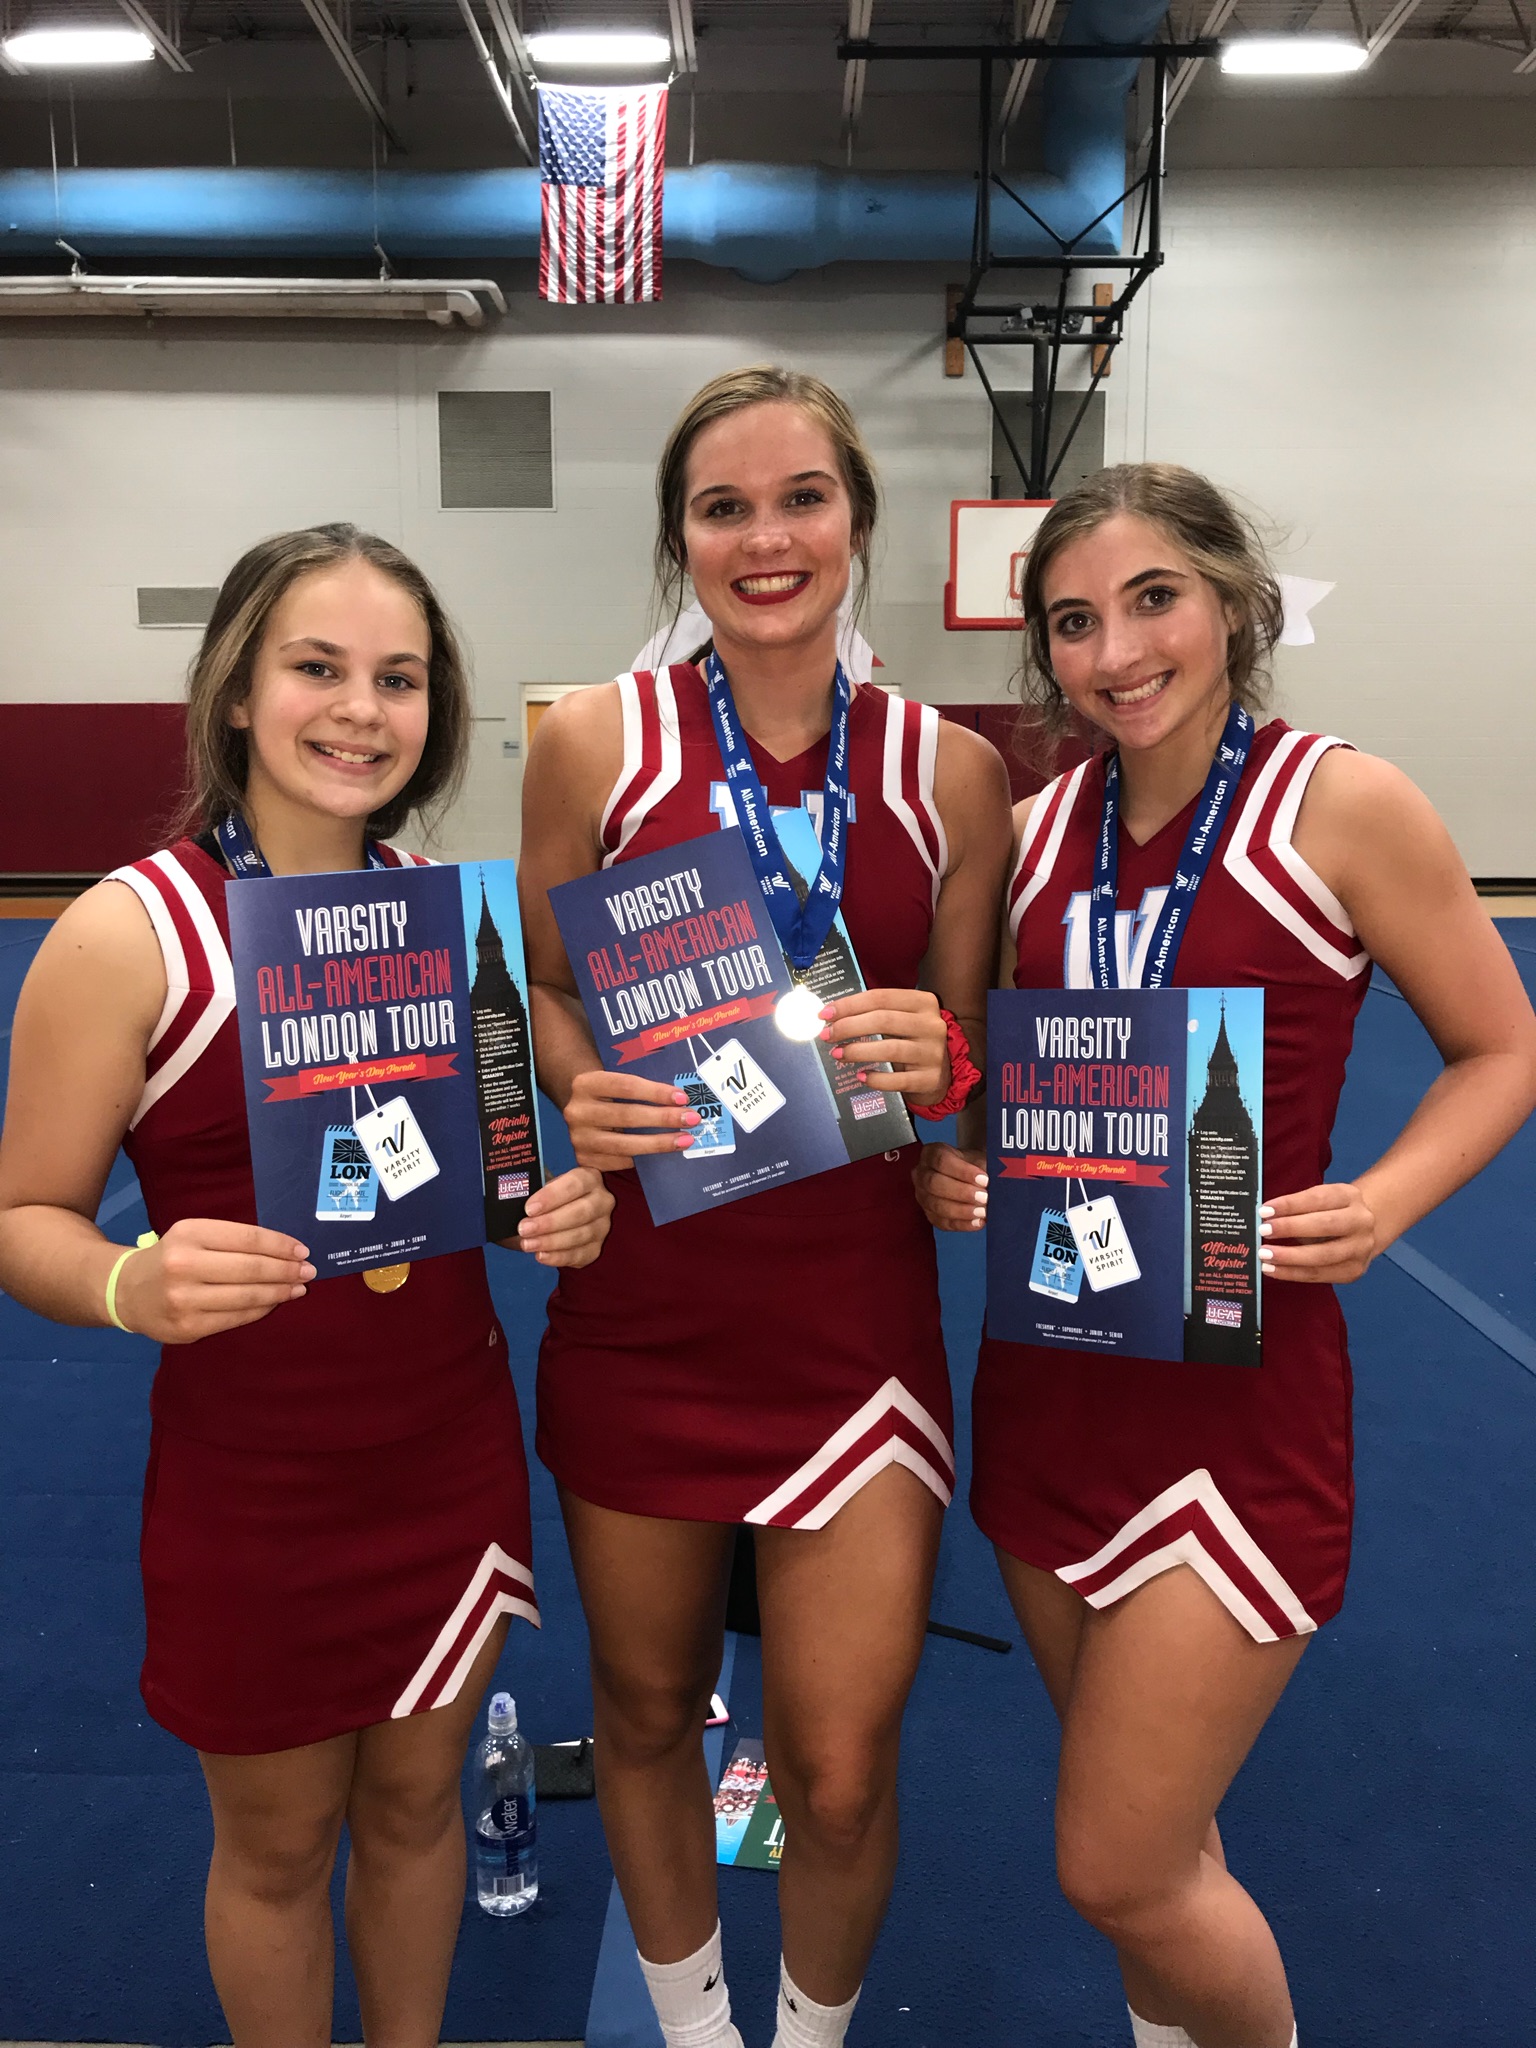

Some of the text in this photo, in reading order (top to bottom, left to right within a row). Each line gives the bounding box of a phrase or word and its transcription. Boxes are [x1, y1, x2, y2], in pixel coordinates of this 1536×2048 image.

[717, 698, 735, 752] All-American
[835, 711, 847, 771] All-American
[741, 788, 768, 857] All-American
[1191, 779, 1228, 855] All-American
[1101, 800, 1113, 870] All-American
[605, 868, 705, 935] VARSITY
[295, 901, 408, 956] VARSITY
[587, 900, 758, 992] ALL-AMERICAN
[1097, 917, 1110, 988] All-America
[1150, 908, 1181, 988] All-American
[257, 948, 452, 1014] ALL-AMERICAN
[600, 967, 703, 1036] LONDON
[701, 944, 773, 1000] TOUR
[261, 1009, 379, 1068] LONDON
[386, 999, 456, 1052] TOUR
[653, 1006, 740, 1042] New Year's Day Parade
[1036, 1016, 1131, 1060] VARSITY
[313, 1061, 416, 1085] New Year's Day Parade
[1001, 1062, 1169, 1108] ALL-AMERICAN
[734, 1082, 764, 1109] VARSITY
[742, 1091, 767, 1113] SPIRIT
[854, 1100, 880, 1113] UCA
[488, 1114, 530, 1131] Officially
[697, 1104, 722, 1119] ON
[492, 1130, 529, 1146] Register
[1001, 1108, 1168, 1157] LONDON TOUR
[330, 1165, 371, 1179] LON
[384, 1148, 421, 1174] VARSITY
[392, 1158, 421, 1179] SPIRIT
[756, 1166, 770, 1175] JUNIOR
[775, 1160, 789, 1169] SENIOR
[1036, 1161, 1126, 1175] New Year's Day Parade
[500, 1180, 524, 1193] UCA
[390, 1239, 405, 1248] JUNIOR
[412, 1235, 426, 1243] SENIOR
[1043, 1243, 1078, 1265] LON
[1201, 1241, 1250, 1258] Officially
[1089, 1248, 1124, 1264] VARSITY
[1096, 1258, 1124, 1272] SPIRIT
[1203, 1256, 1247, 1270] Register
[1208, 1307, 1235, 1320] UCA
[1109, 1331, 1123, 1339] SENIOR
[502, 1799, 518, 1834] water
